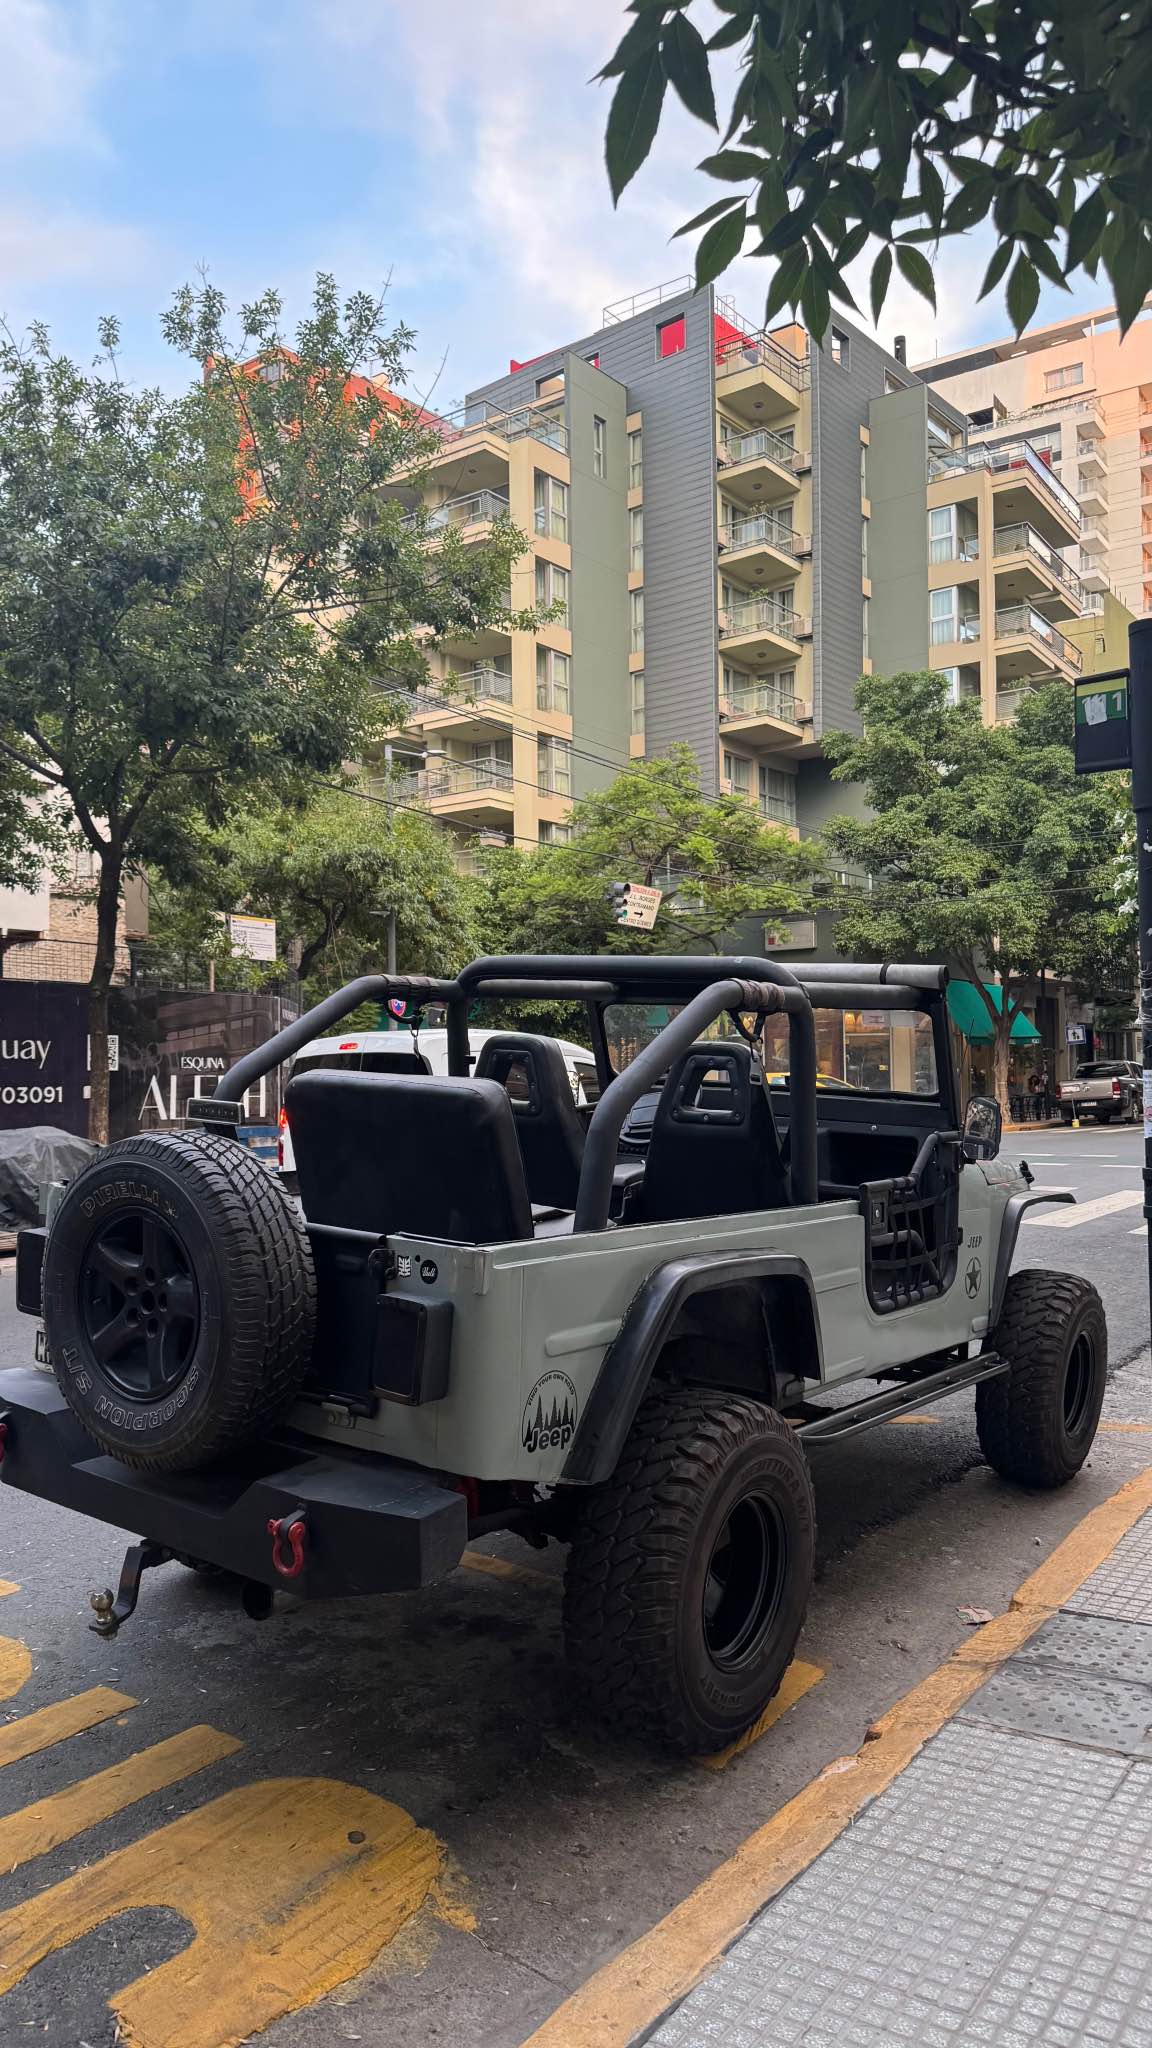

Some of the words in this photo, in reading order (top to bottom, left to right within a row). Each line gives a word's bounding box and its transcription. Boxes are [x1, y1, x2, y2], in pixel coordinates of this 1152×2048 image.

[180, 1056, 225, 1071] ESQUINA
[0, 1085, 63, 1104] 03091
[79, 1181, 160, 1218] PIRELLI
[967, 1235, 983, 1249] JEEP
[538, 1374, 551, 1387] YOUR
[94, 1365, 200, 1432] SCORPION
[527, 1425, 572, 1453] Jeep
